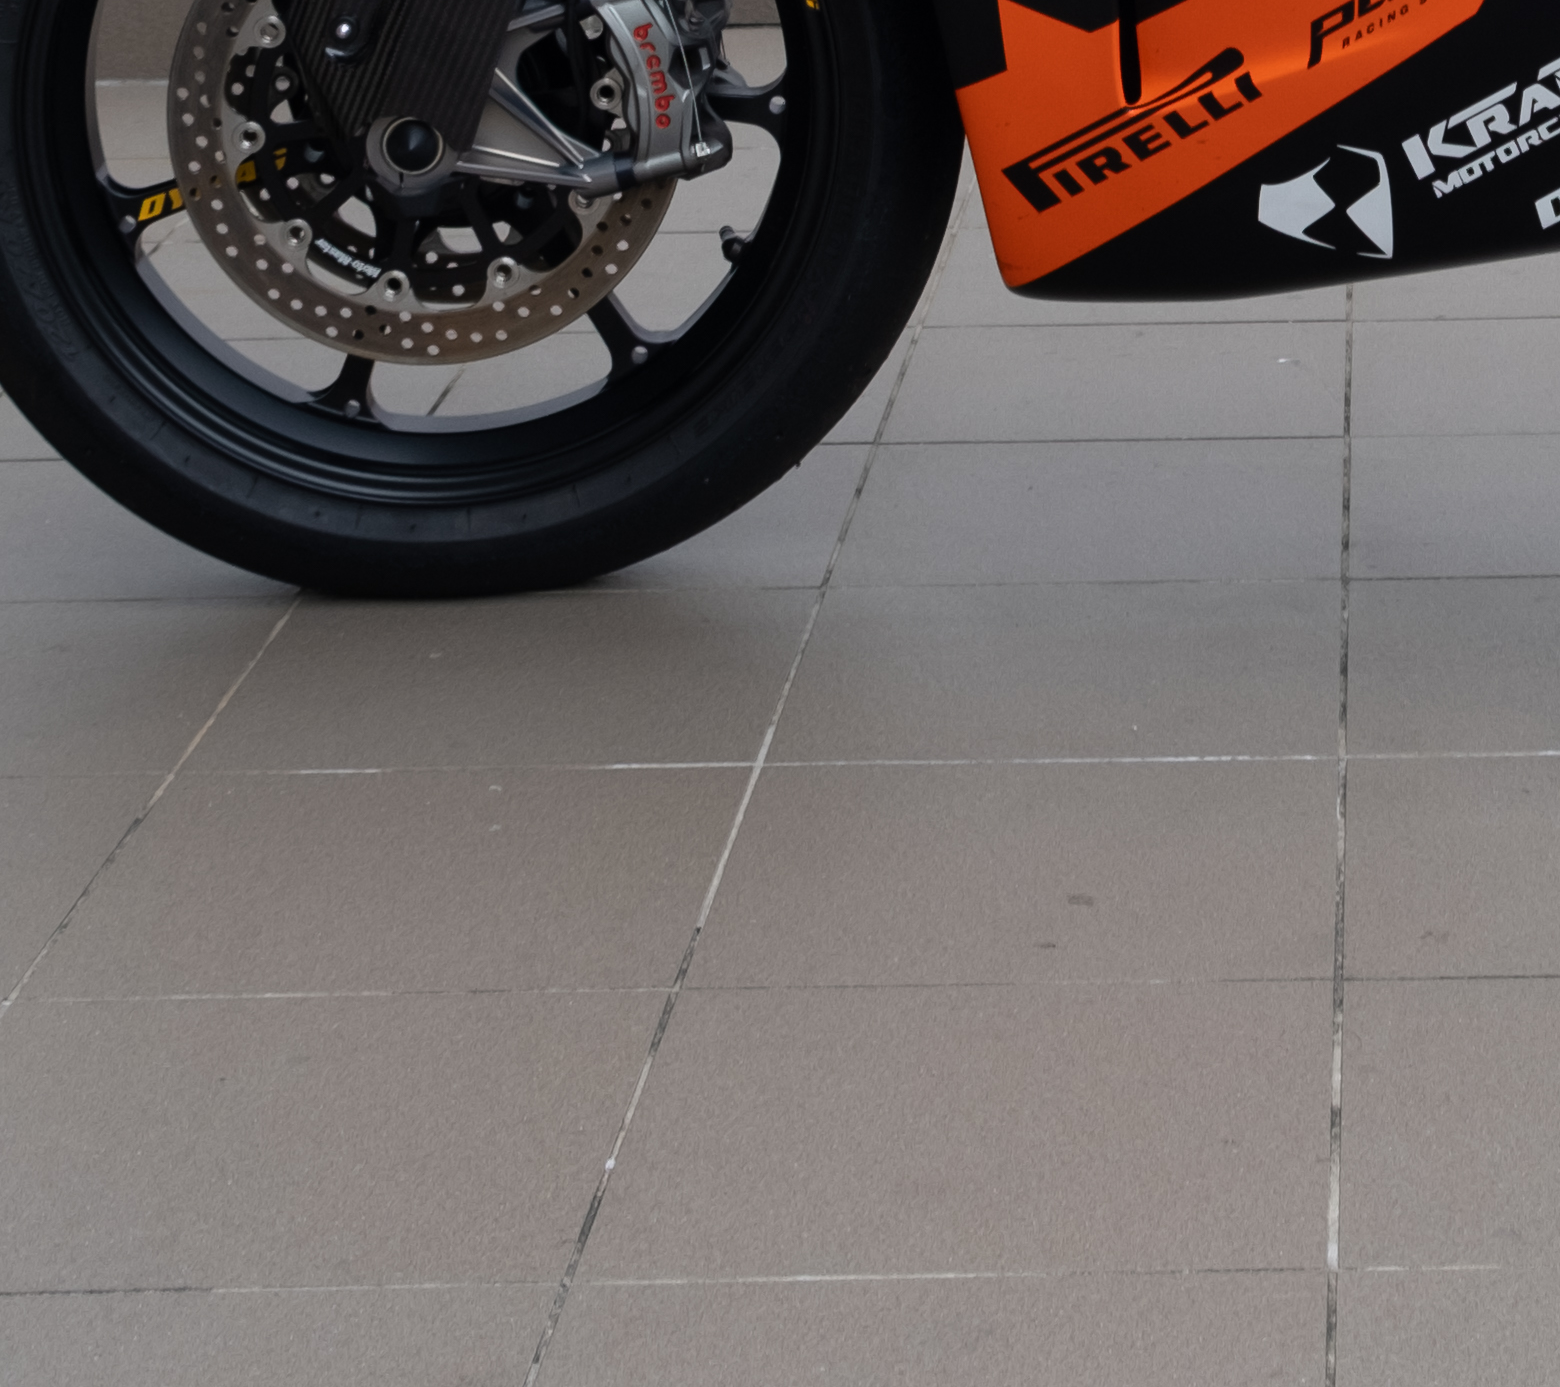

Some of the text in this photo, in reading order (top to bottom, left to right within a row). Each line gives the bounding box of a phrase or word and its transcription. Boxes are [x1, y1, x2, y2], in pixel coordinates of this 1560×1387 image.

[633, 22, 676, 129] brembo
[1341, 5, 1410, 49] RACING
[1002, 47, 1263, 214] PIRELLI
